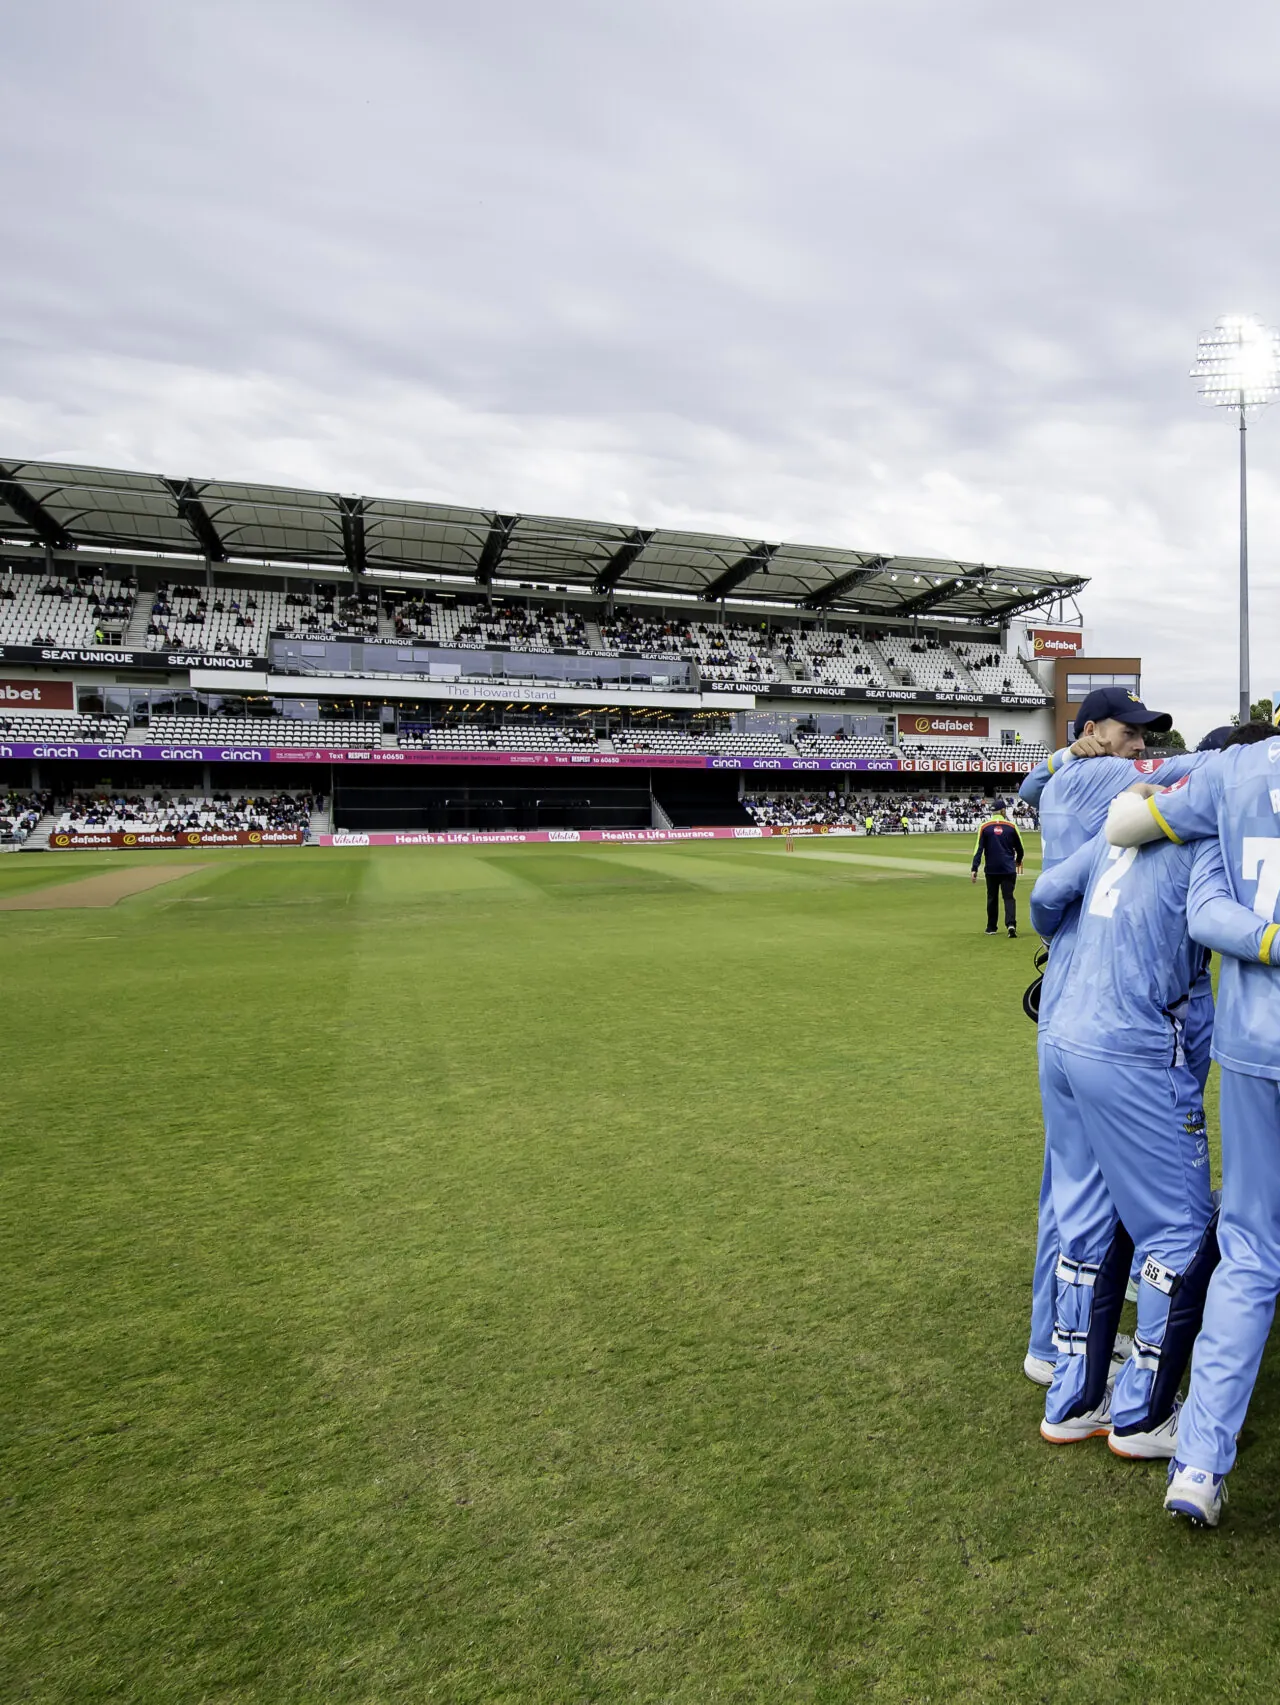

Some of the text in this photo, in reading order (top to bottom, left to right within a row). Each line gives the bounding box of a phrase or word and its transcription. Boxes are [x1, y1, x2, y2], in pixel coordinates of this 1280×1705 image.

[384, 638, 413, 646] UNIQUE
[458, 642, 486, 650] UNIQUE
[1045, 640, 1077, 650] dafabet
[42, 650, 134, 663] SEAT UNIQUE
[168, 656, 253, 668] SEAT UNIQUE
[712, 682, 770, 692] SEAT UNIQUE
[792, 686, 846, 696] SEAT UNIQUE
[446, 686, 556, 700] The Howard Stand
[1020, 697, 1046, 705] UNIQUE
[932, 720, 974, 732] dafabet
[33, 744, 78, 758] cinch
[98, 745, 142, 758] cinch
[161, 747, 202, 760] cinch
[220, 748, 261, 760] cinch
[712, 756, 740, 768] cinch
[753, 758, 780, 768] cinch
[792, 758, 820, 769] cinch
[830, 760, 856, 769] cinch
[868, 760, 892, 770] cinch
[902, 761, 912, 770] IG
[918, 761, 930, 770] IG
[936, 762, 946, 770] IG
[952, 762, 964, 770] IG
[970, 762, 980, 770] IG
[986, 762, 996, 770] IG
[1003, 762, 1013, 771] IG
[1018, 762, 1028, 771] IG
[602, 831, 636, 840] Health
[647, 830, 666, 838] Life
[790, 826, 814, 834] dafabet
[70, 836, 112, 844] dafabet
[202, 834, 238, 842] dafabet
[262, 832, 298, 840] dafabet
[334, 834, 368, 844] Vitality
[396, 834, 526, 844] Health & Life insurance
[1144, 1262, 1160, 1280] SS
